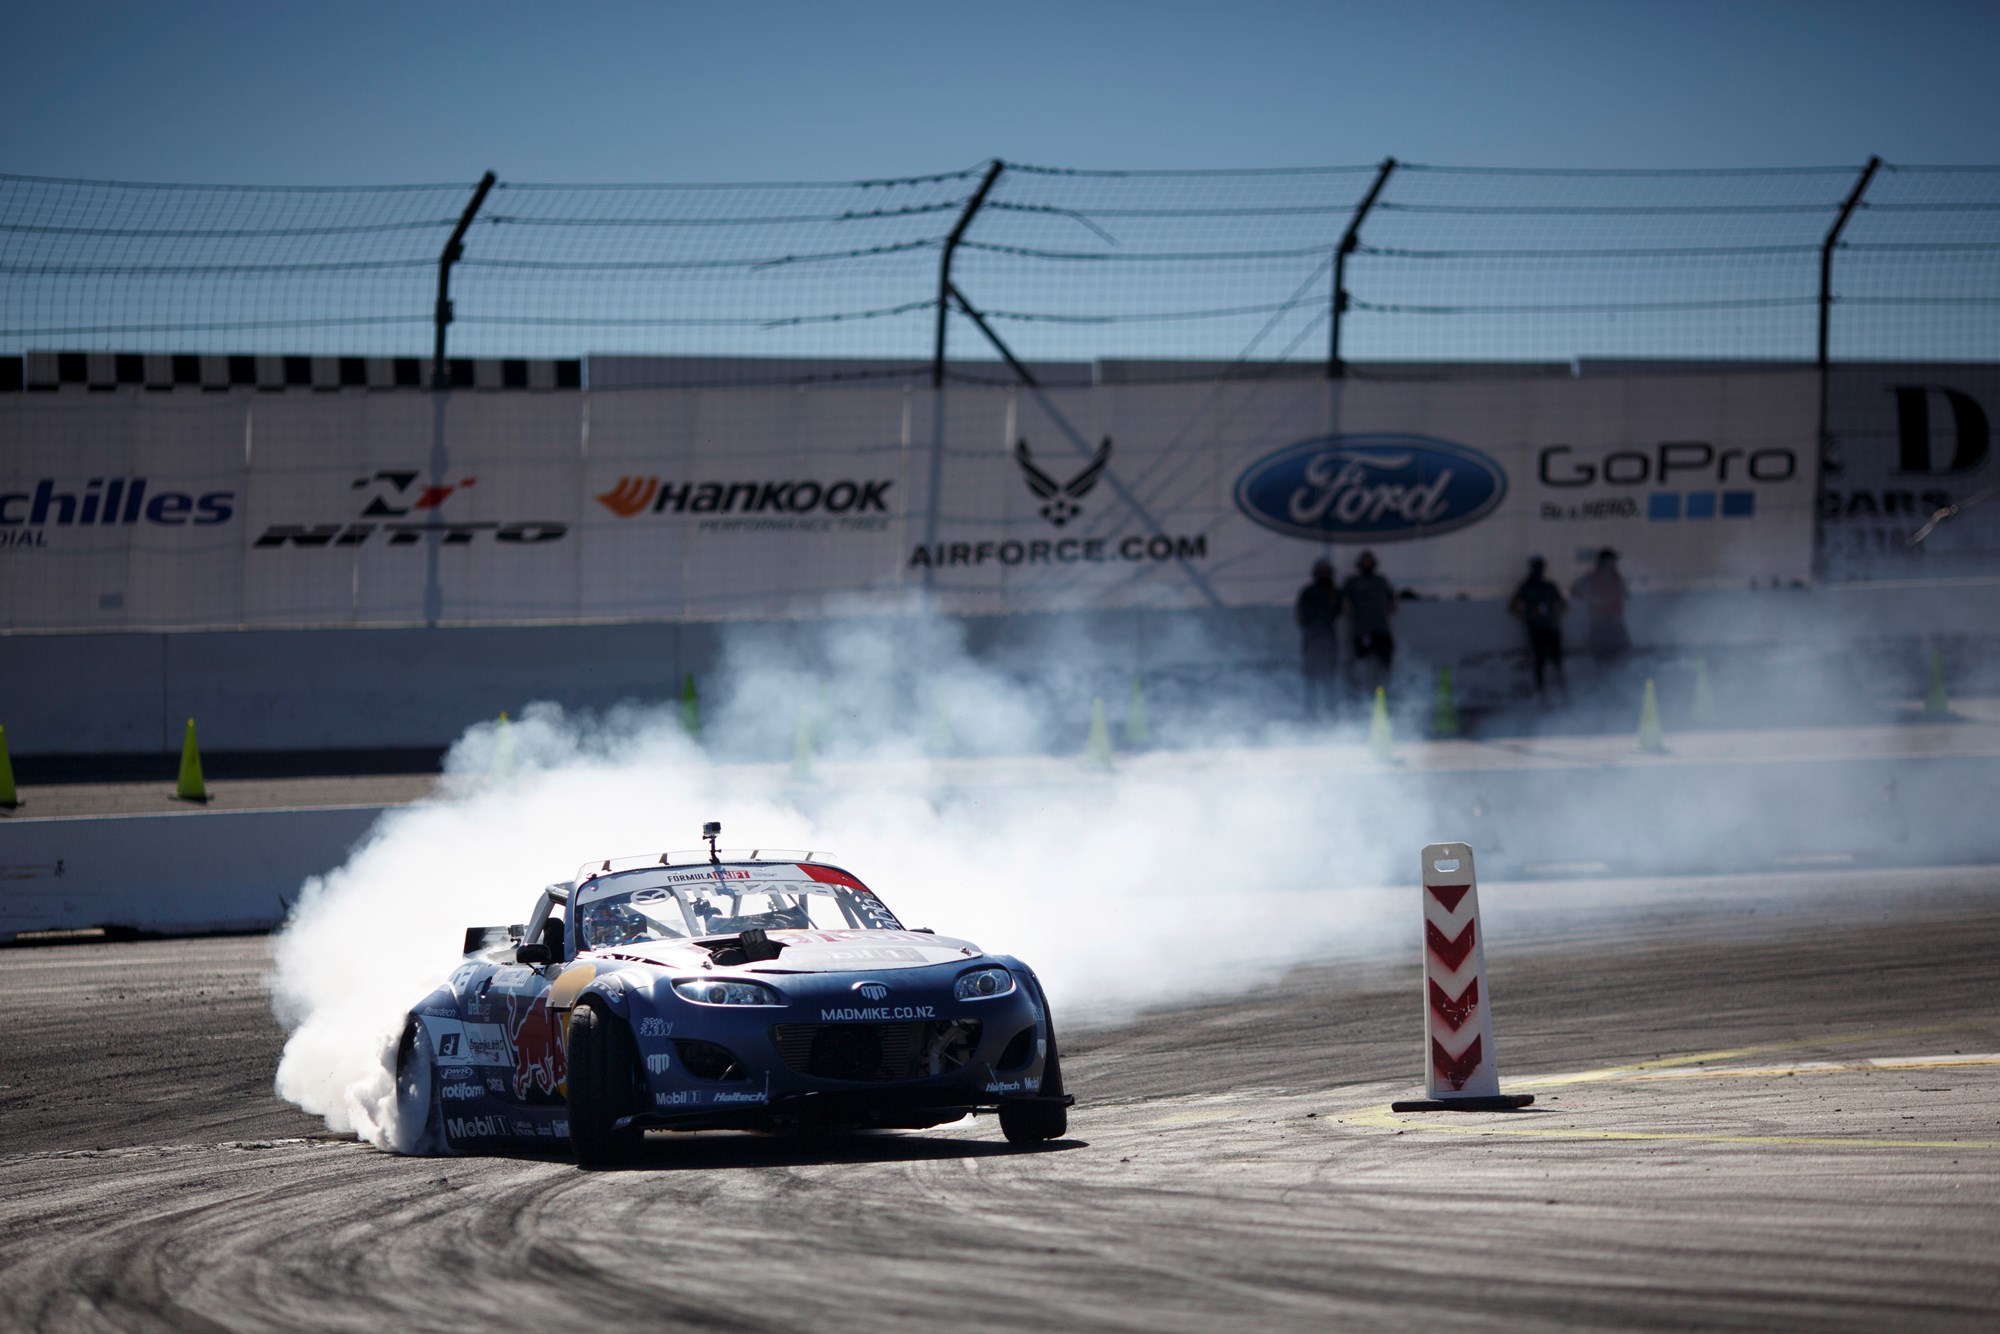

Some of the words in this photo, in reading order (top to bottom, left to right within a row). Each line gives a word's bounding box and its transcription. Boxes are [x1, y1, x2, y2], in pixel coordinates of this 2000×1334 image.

[1538, 441, 1797, 487] GoPro
[1288, 451, 1454, 525] Ford
[253, 520, 568, 549] NITTO
[910, 534, 1206, 568] AIRFORCE.COM
[667, 872, 713, 882] FORMULA
[821, 1006, 935, 1021] MADMIKE.CO.NZ
[442, 1082, 485, 1101] rotiform
[986, 1081, 1019, 1092] Haltech
[656, 1090, 687, 1105] Mobil
[712, 1091, 767, 1103] Haltech
[447, 1115, 497, 1139] Mobil
